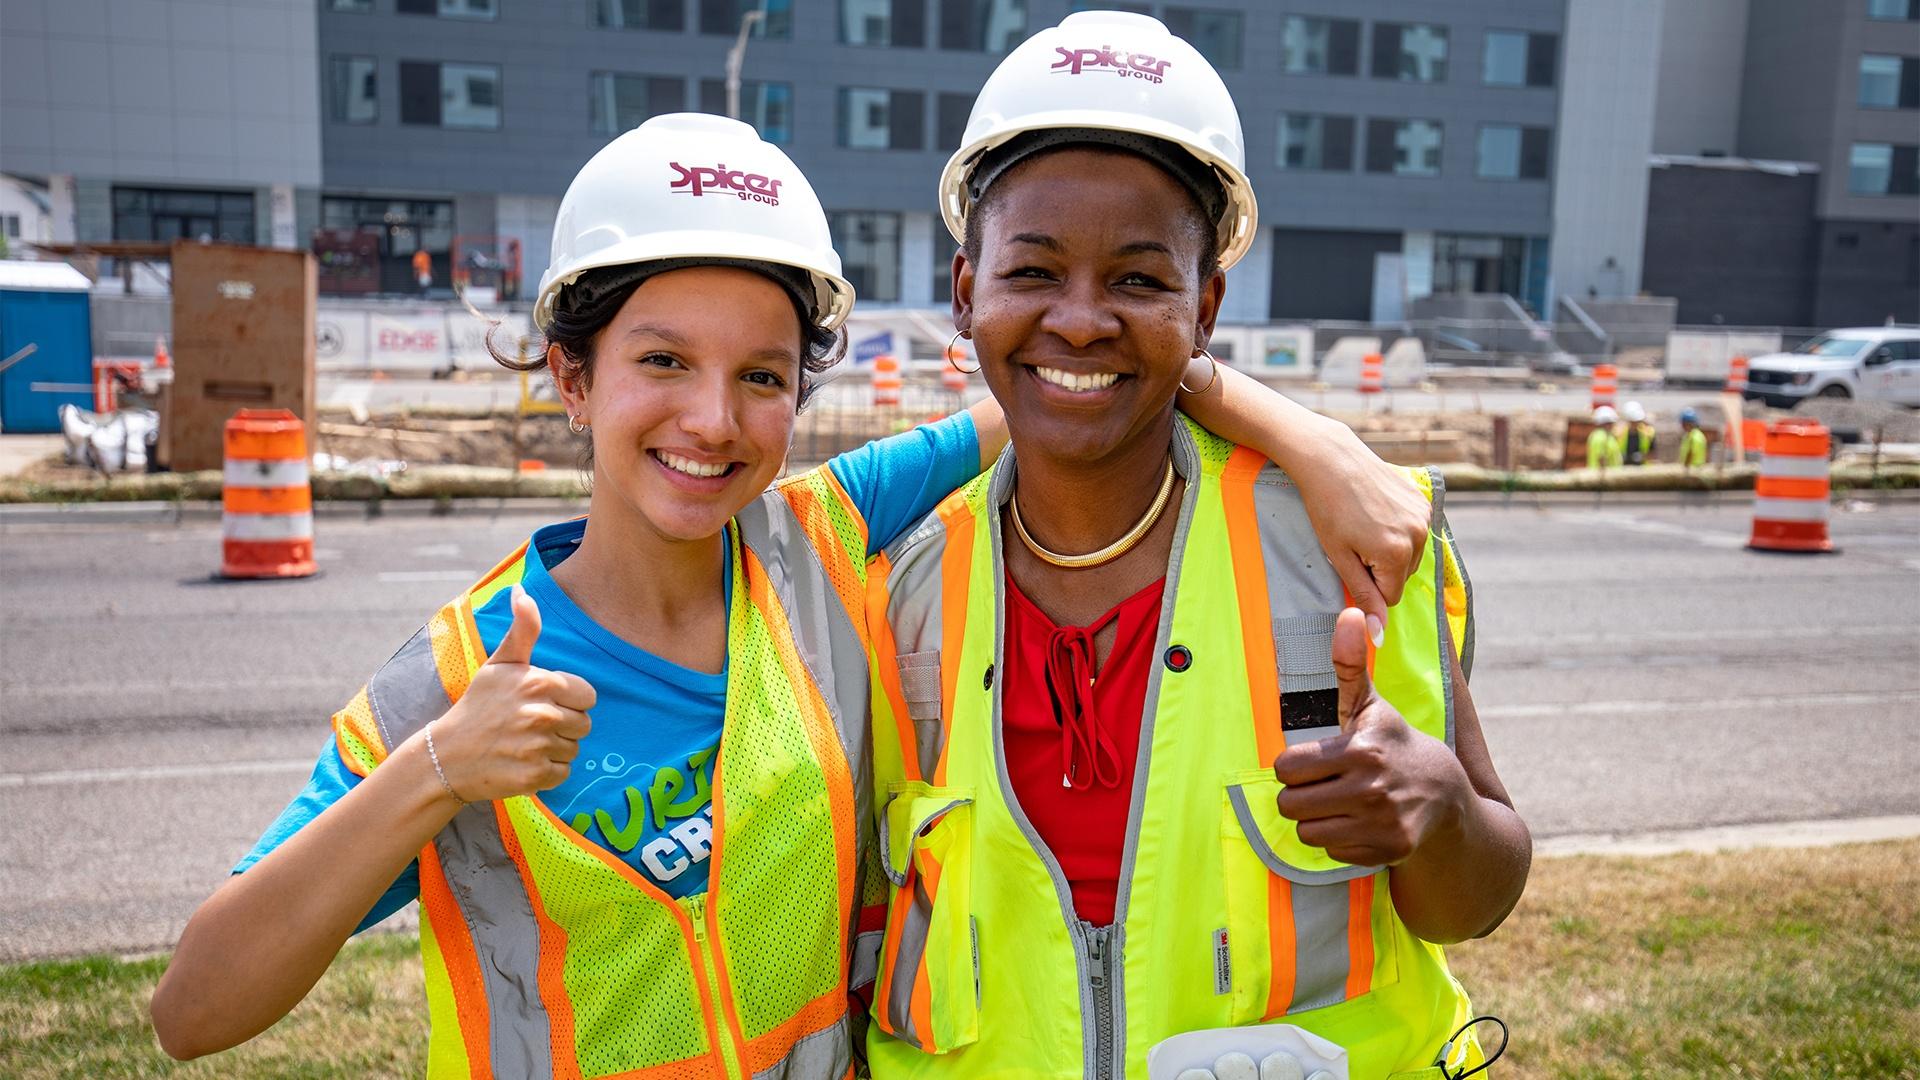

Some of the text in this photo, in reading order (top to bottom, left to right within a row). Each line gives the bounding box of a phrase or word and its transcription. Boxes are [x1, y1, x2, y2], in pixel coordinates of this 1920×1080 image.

[1118, 69, 1163, 84] group
[738, 191, 779, 207] group
[378, 329, 440, 352] EDGE
[641, 806, 713, 882] CR
